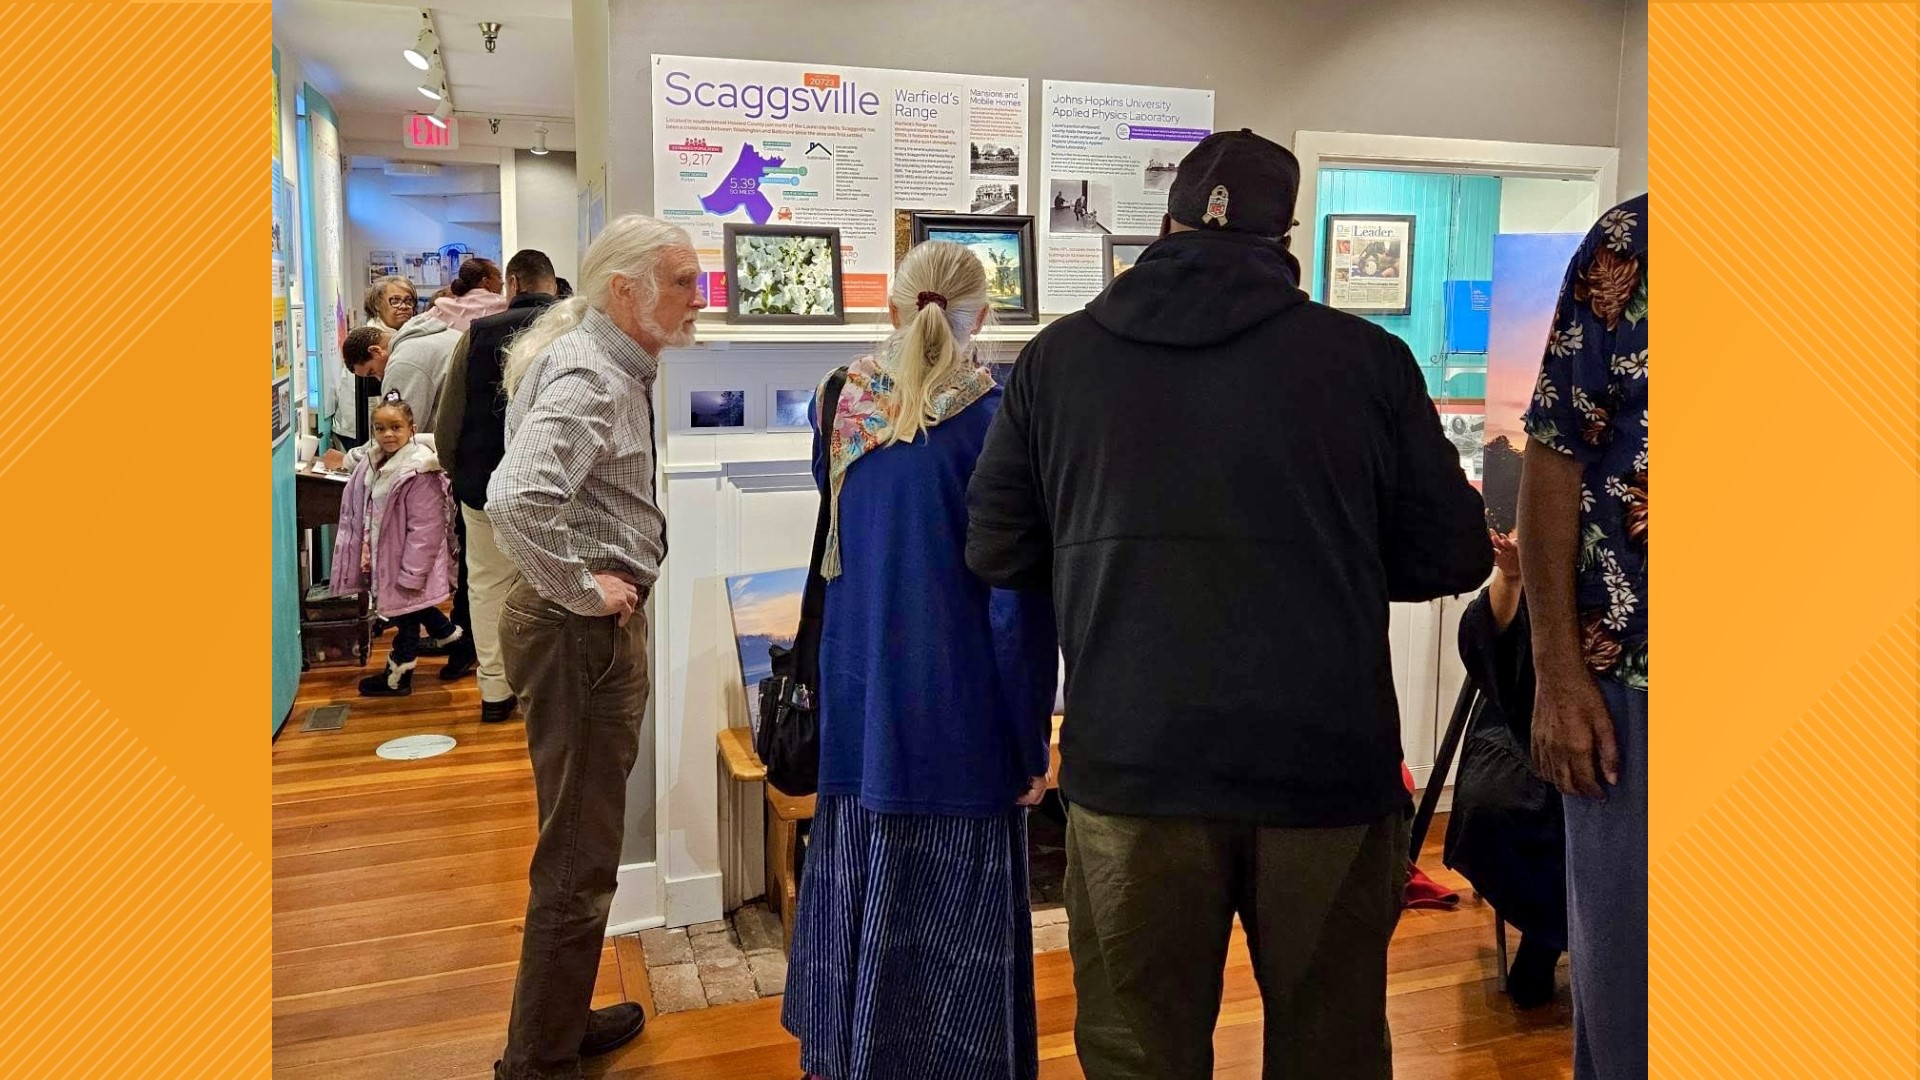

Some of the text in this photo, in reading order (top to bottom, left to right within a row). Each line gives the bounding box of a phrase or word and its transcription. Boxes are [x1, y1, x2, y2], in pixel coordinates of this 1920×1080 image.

[810, 77, 835, 87] 20723
[665, 71, 880, 120] Scaggsville
[895, 89, 960, 106] Warfield's
[970, 89, 1018, 99] Mansions and
[970, 97, 1021, 107] Mobile Homes
[1052, 94, 1171, 112] Johns Hopkins University
[895, 104, 938, 121] Range
[1052, 107, 1180, 125] Applied Physics Laboratory
[412, 116, 452, 146] EXIT
[679, 153, 713, 166] 9,217
[729, 178, 756, 189] 5.39
[1353, 225, 1394, 238] Leader
